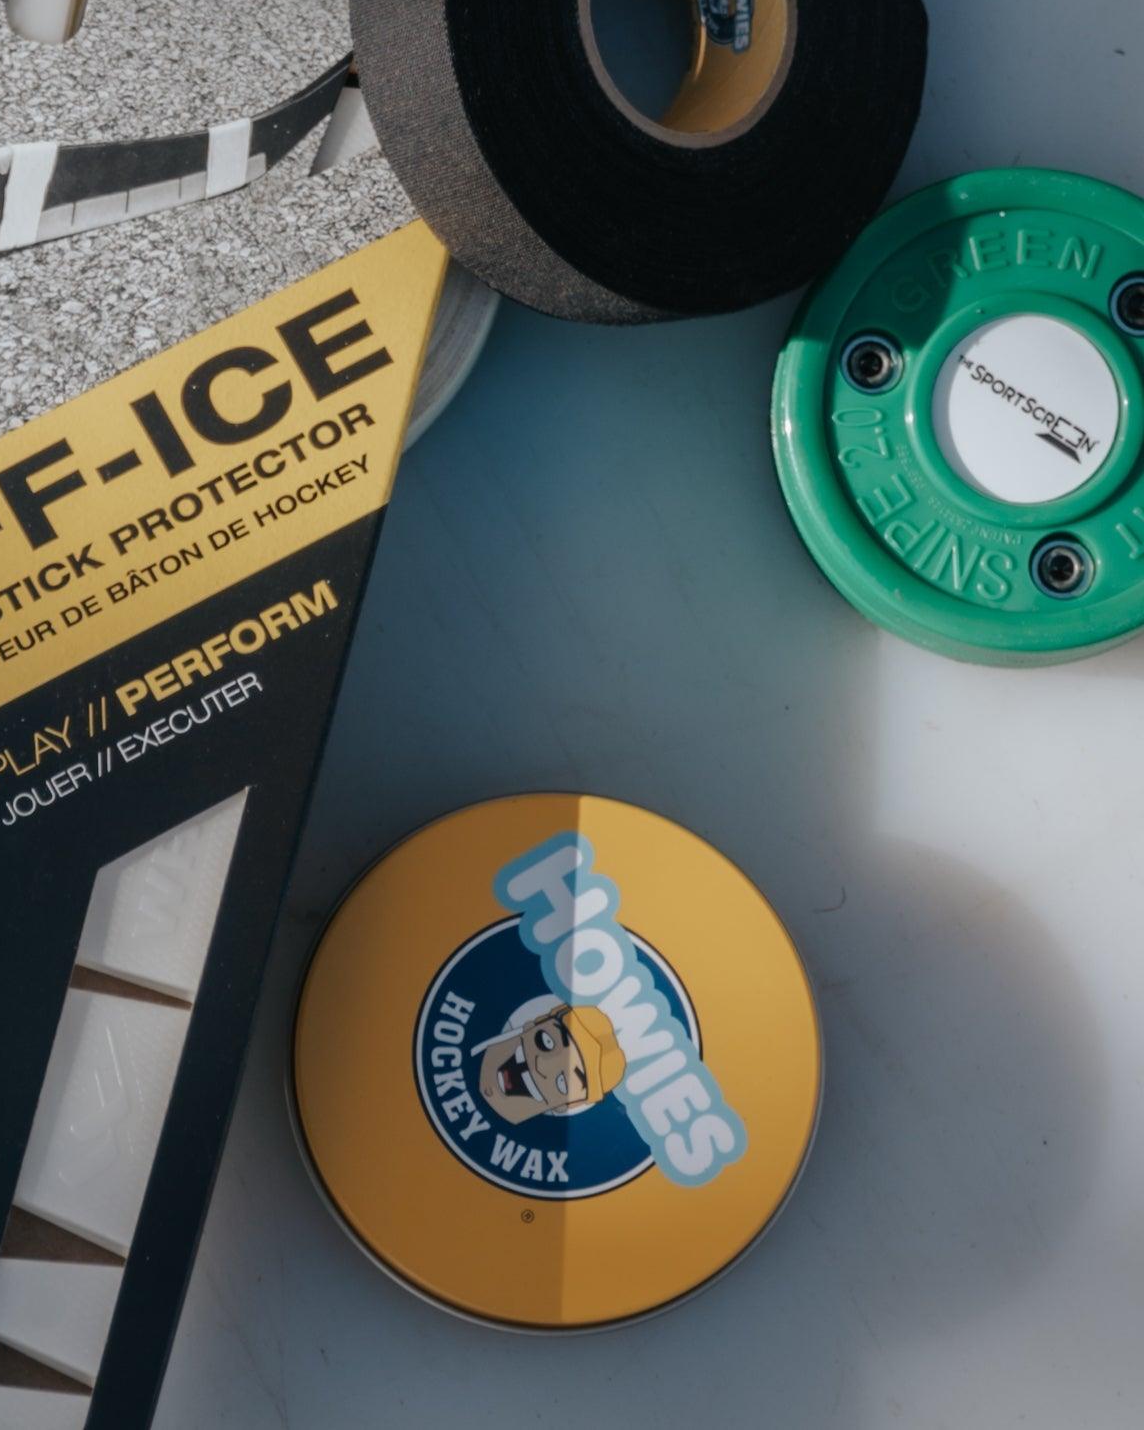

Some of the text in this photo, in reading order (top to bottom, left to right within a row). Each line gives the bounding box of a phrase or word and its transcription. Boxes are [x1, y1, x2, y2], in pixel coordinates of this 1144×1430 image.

[890, 227, 1104, 313] GREEN
[110, 401, 376, 556] PROTECTOR
[832, 406, 893, 470] 2.0
[60, 596, 105, 630] DE
[106, 541, 206, 603] BÂTON
[208, 520, 251, 552] DE
[254, 454, 372, 528] HOCKEY
[858, 473, 1016, 603] SNIPE
[114, 580, 339, 718] PERFORM
[0, 762, 93, 828] JOUER
[114, 671, 264, 765] EXECUTER
[430, 990, 570, 1183] HOCKEY WAX
[507, 844, 736, 1177] HOWIES
